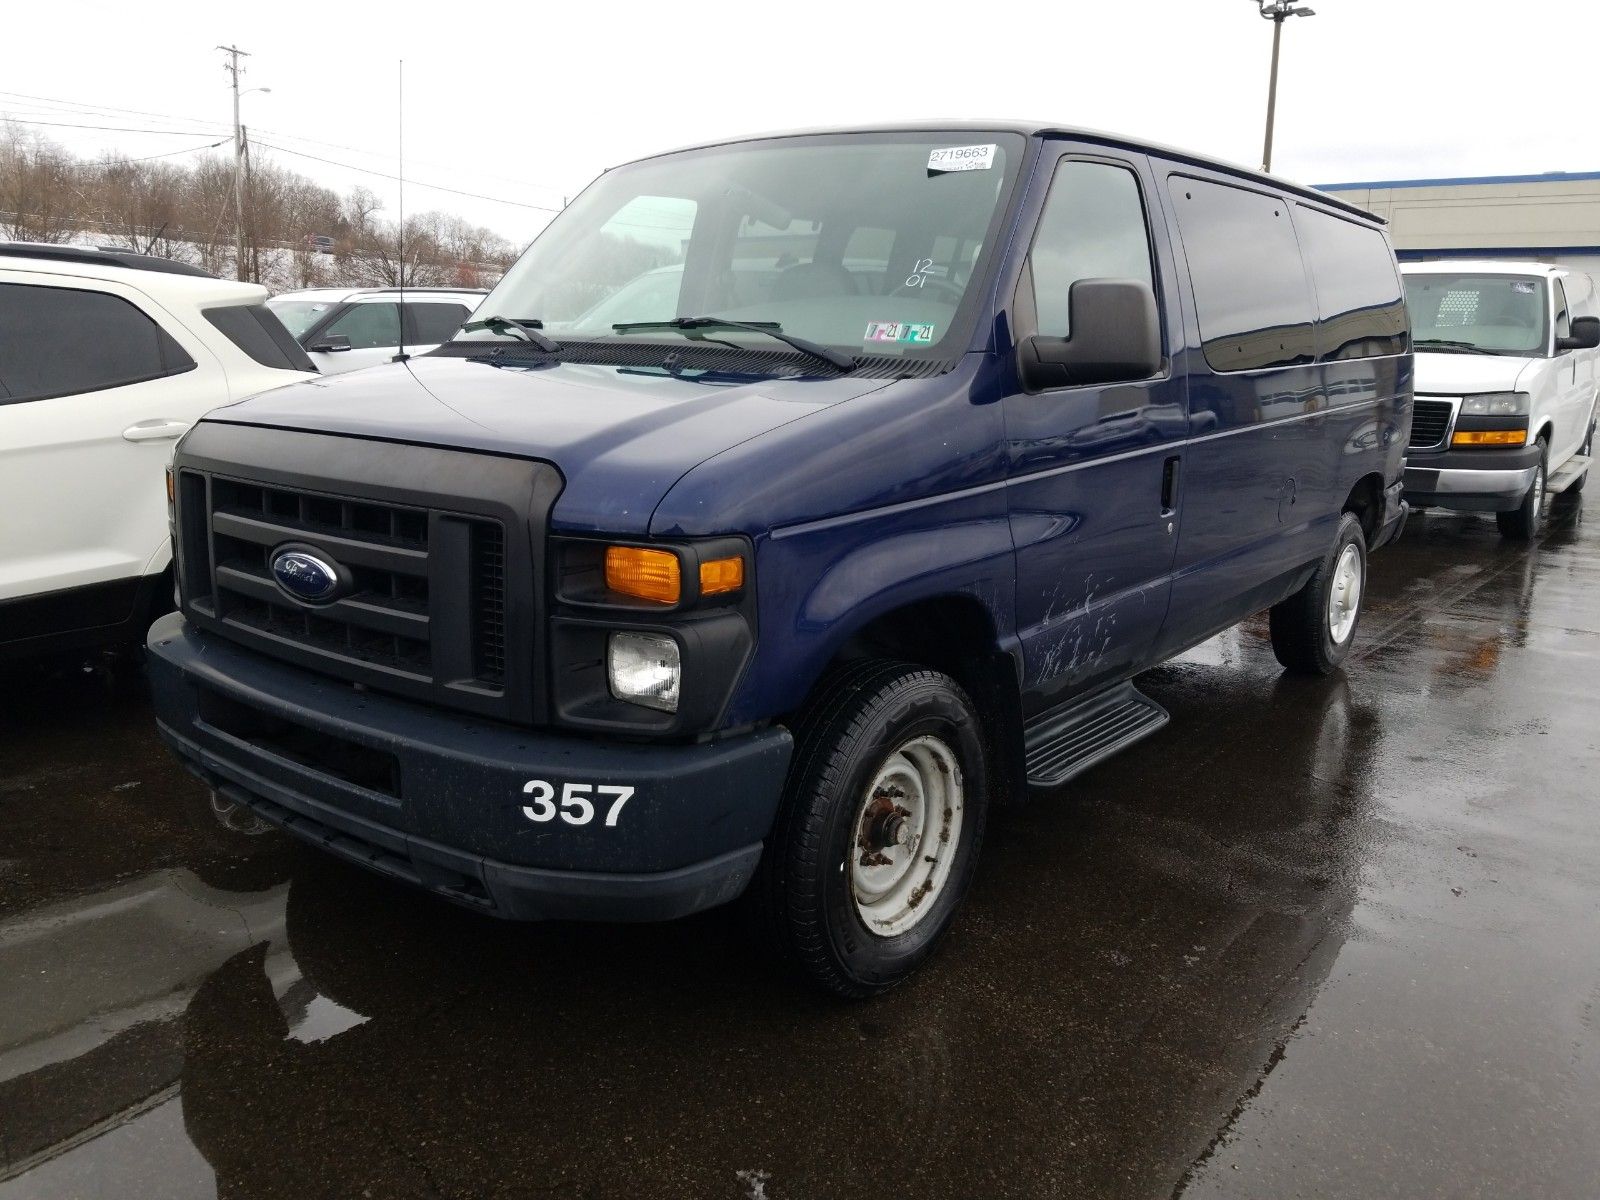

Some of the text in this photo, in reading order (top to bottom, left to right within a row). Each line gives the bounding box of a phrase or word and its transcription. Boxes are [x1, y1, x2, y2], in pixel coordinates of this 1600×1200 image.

[930, 147, 988, 162] 2719663
[913, 258, 935, 274] 12
[905, 274, 926, 289] 01
[870, 324, 898, 338] 7 21
[903, 325, 931, 340] 7 21
[522, 779, 635, 826] 357
